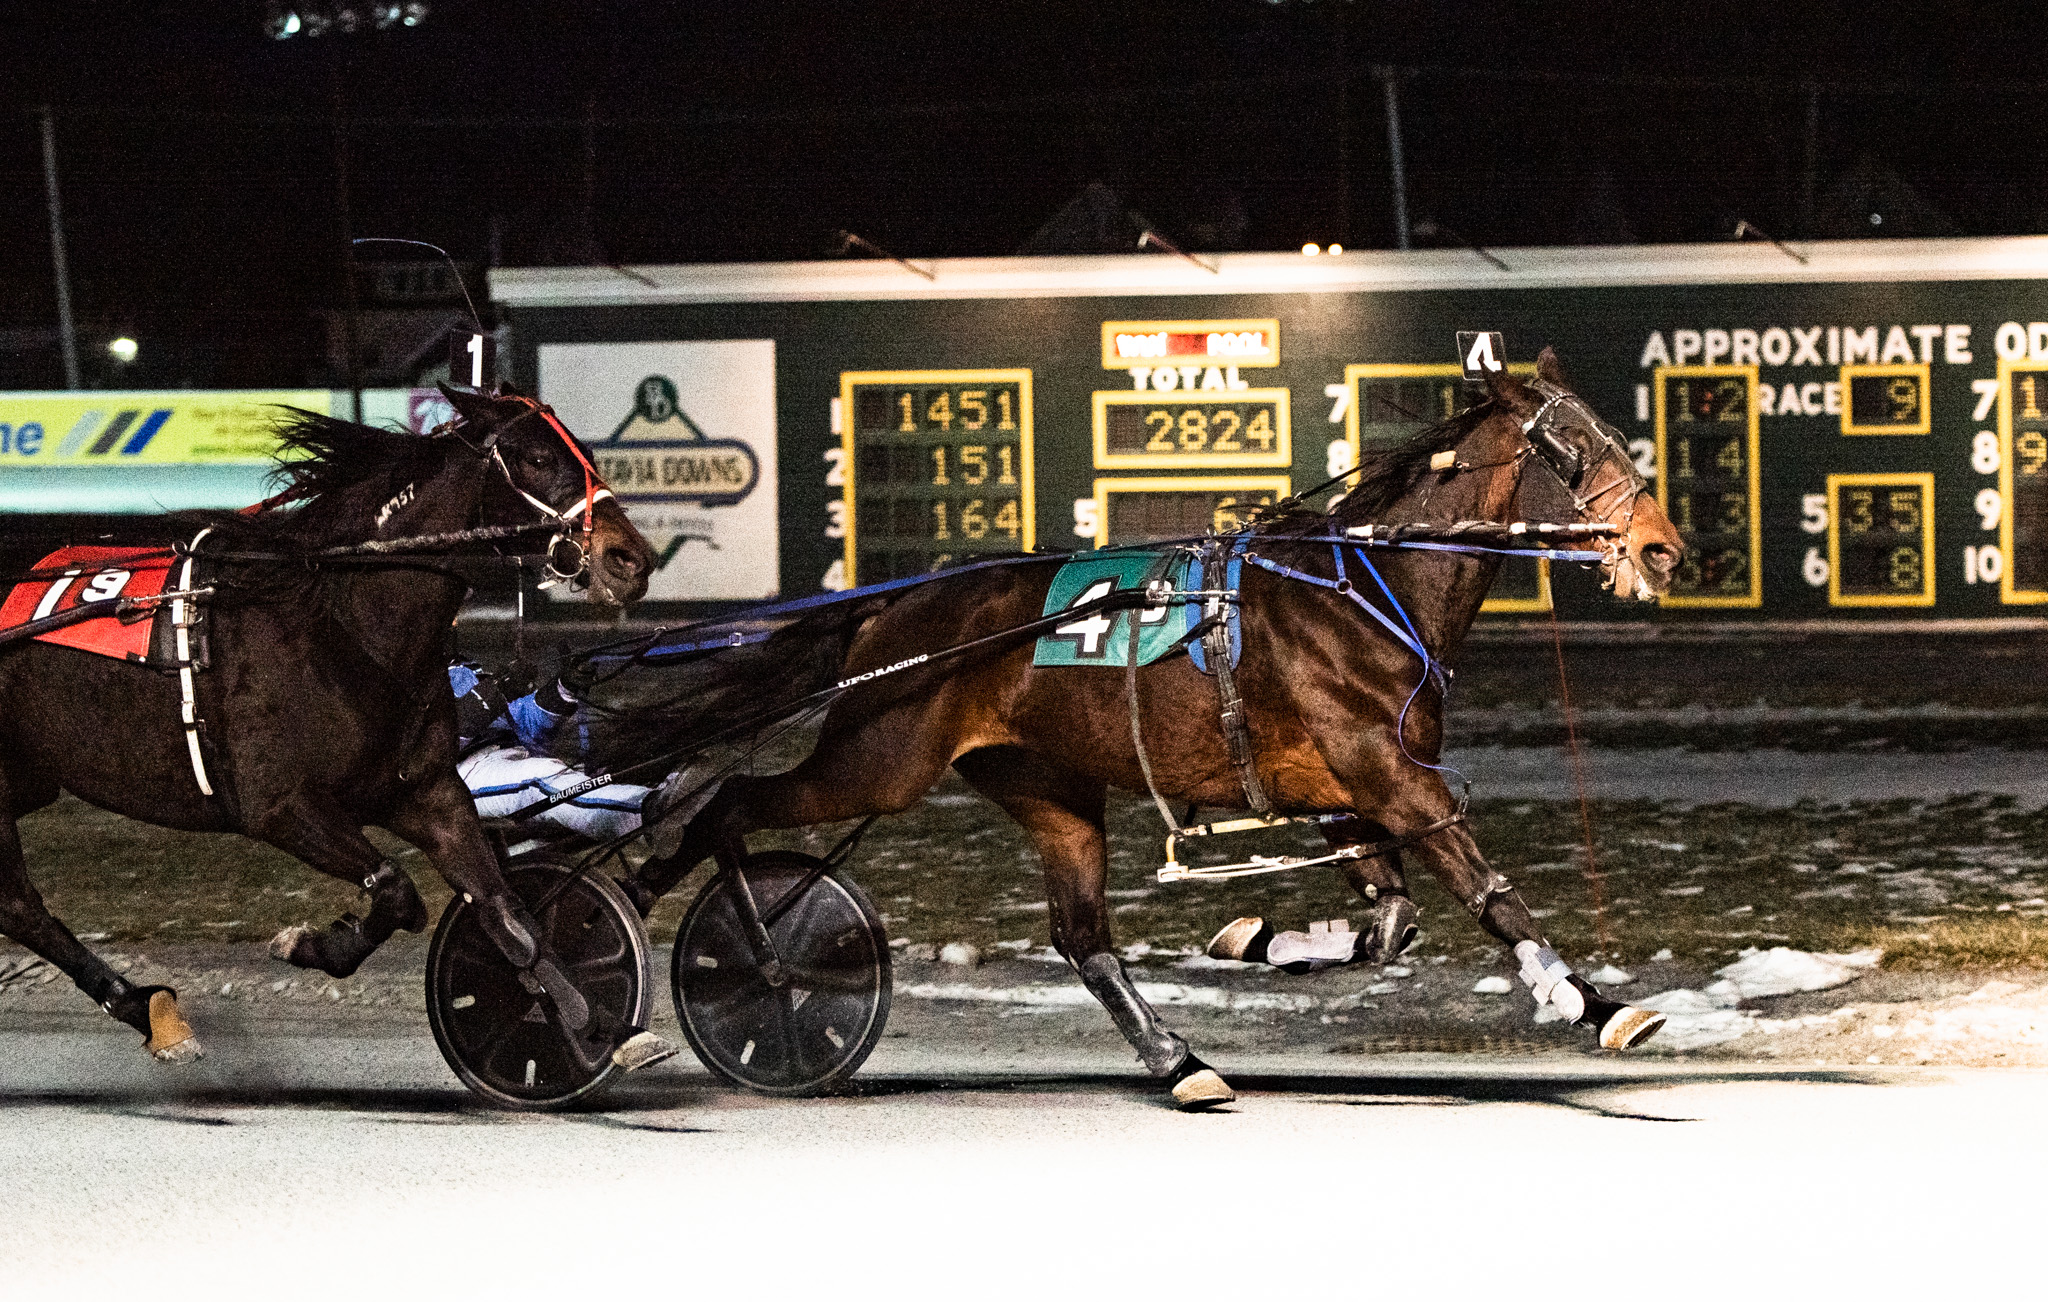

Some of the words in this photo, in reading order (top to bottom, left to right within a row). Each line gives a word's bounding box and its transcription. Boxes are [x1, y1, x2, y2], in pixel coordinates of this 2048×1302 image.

[467, 334, 483, 387] 1
[1467, 332, 1502, 372] 4
[1640, 324, 1973, 367] APPROXIMATE
[1129, 366, 1248, 391] TOTAL
[830, 397, 843, 434] 1
[899, 391, 1016, 432] 1451
[1324, 384, 1350, 422] 7
[1635, 384, 1649, 420] 1
[1758, 382, 1842, 416] RACE
[1887, 377, 1917, 421] 9
[1971, 379, 2000, 421] 7
[1145, 410, 1274, 451] 2824
[824, 448, 846, 486] 2
[932, 446, 1017, 485] 151
[1327, 439, 1352, 480] 8
[1628, 437, 1658, 478] 2
[1971, 430, 2000, 474] 8
[824, 500, 846, 538] 3
[933, 499, 1022, 540] 164
[1073, 498, 1099, 538] 5
[1801, 493, 1829, 533] 5
[1974, 488, 2000, 530] 9
[1803, 547, 1830, 588] 6
[1890, 546, 1919, 588] 8
[1963, 545, 2002, 584] 10
[82, 568, 131, 603] 9
[1056, 581, 1112, 652] 4
[837, 671, 875, 688] UFO
[875, 653, 928, 677] RACING
[549, 773, 613, 804] BAUMEISTER
